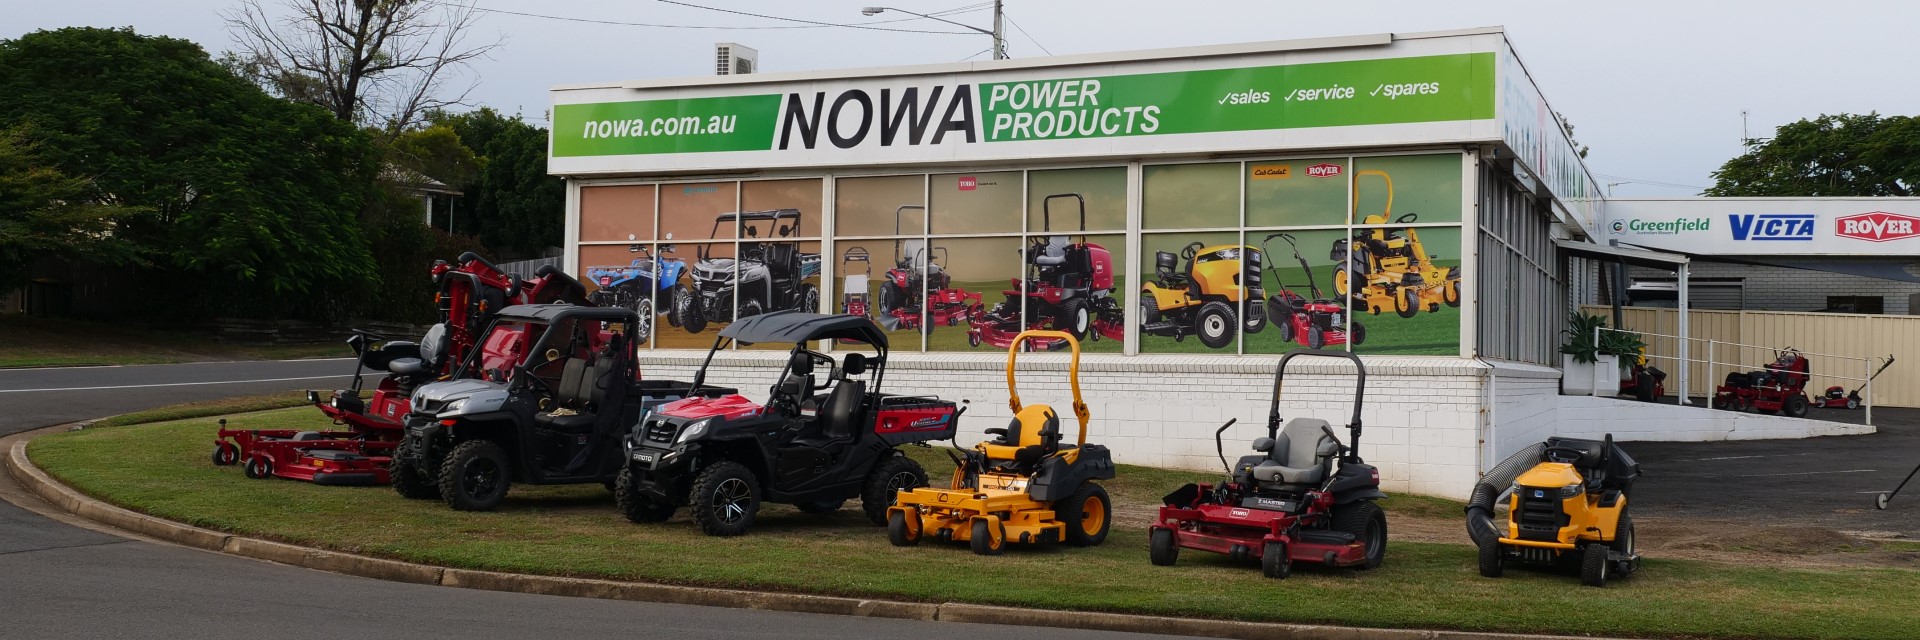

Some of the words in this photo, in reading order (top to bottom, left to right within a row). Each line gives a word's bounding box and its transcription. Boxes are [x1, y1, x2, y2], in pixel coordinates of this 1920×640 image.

[988, 79, 1101, 111] POWER
[1229, 88, 1270, 106] sales
[1296, 83, 1355, 102] service
[1383, 81, 1440, 100] spares
[583, 111, 737, 139] nowa.com.au
[778, 84, 977, 150] NOWA
[991, 105, 1160, 140] PRODUCTS
[1267, 168, 1287, 176] Cadet
[1309, 166, 1338, 177] ROVER
[1629, 217, 1710, 235] Greenfield
[1728, 214, 1815, 241] VICTA
[1844, 215, 1913, 240] ROVER
